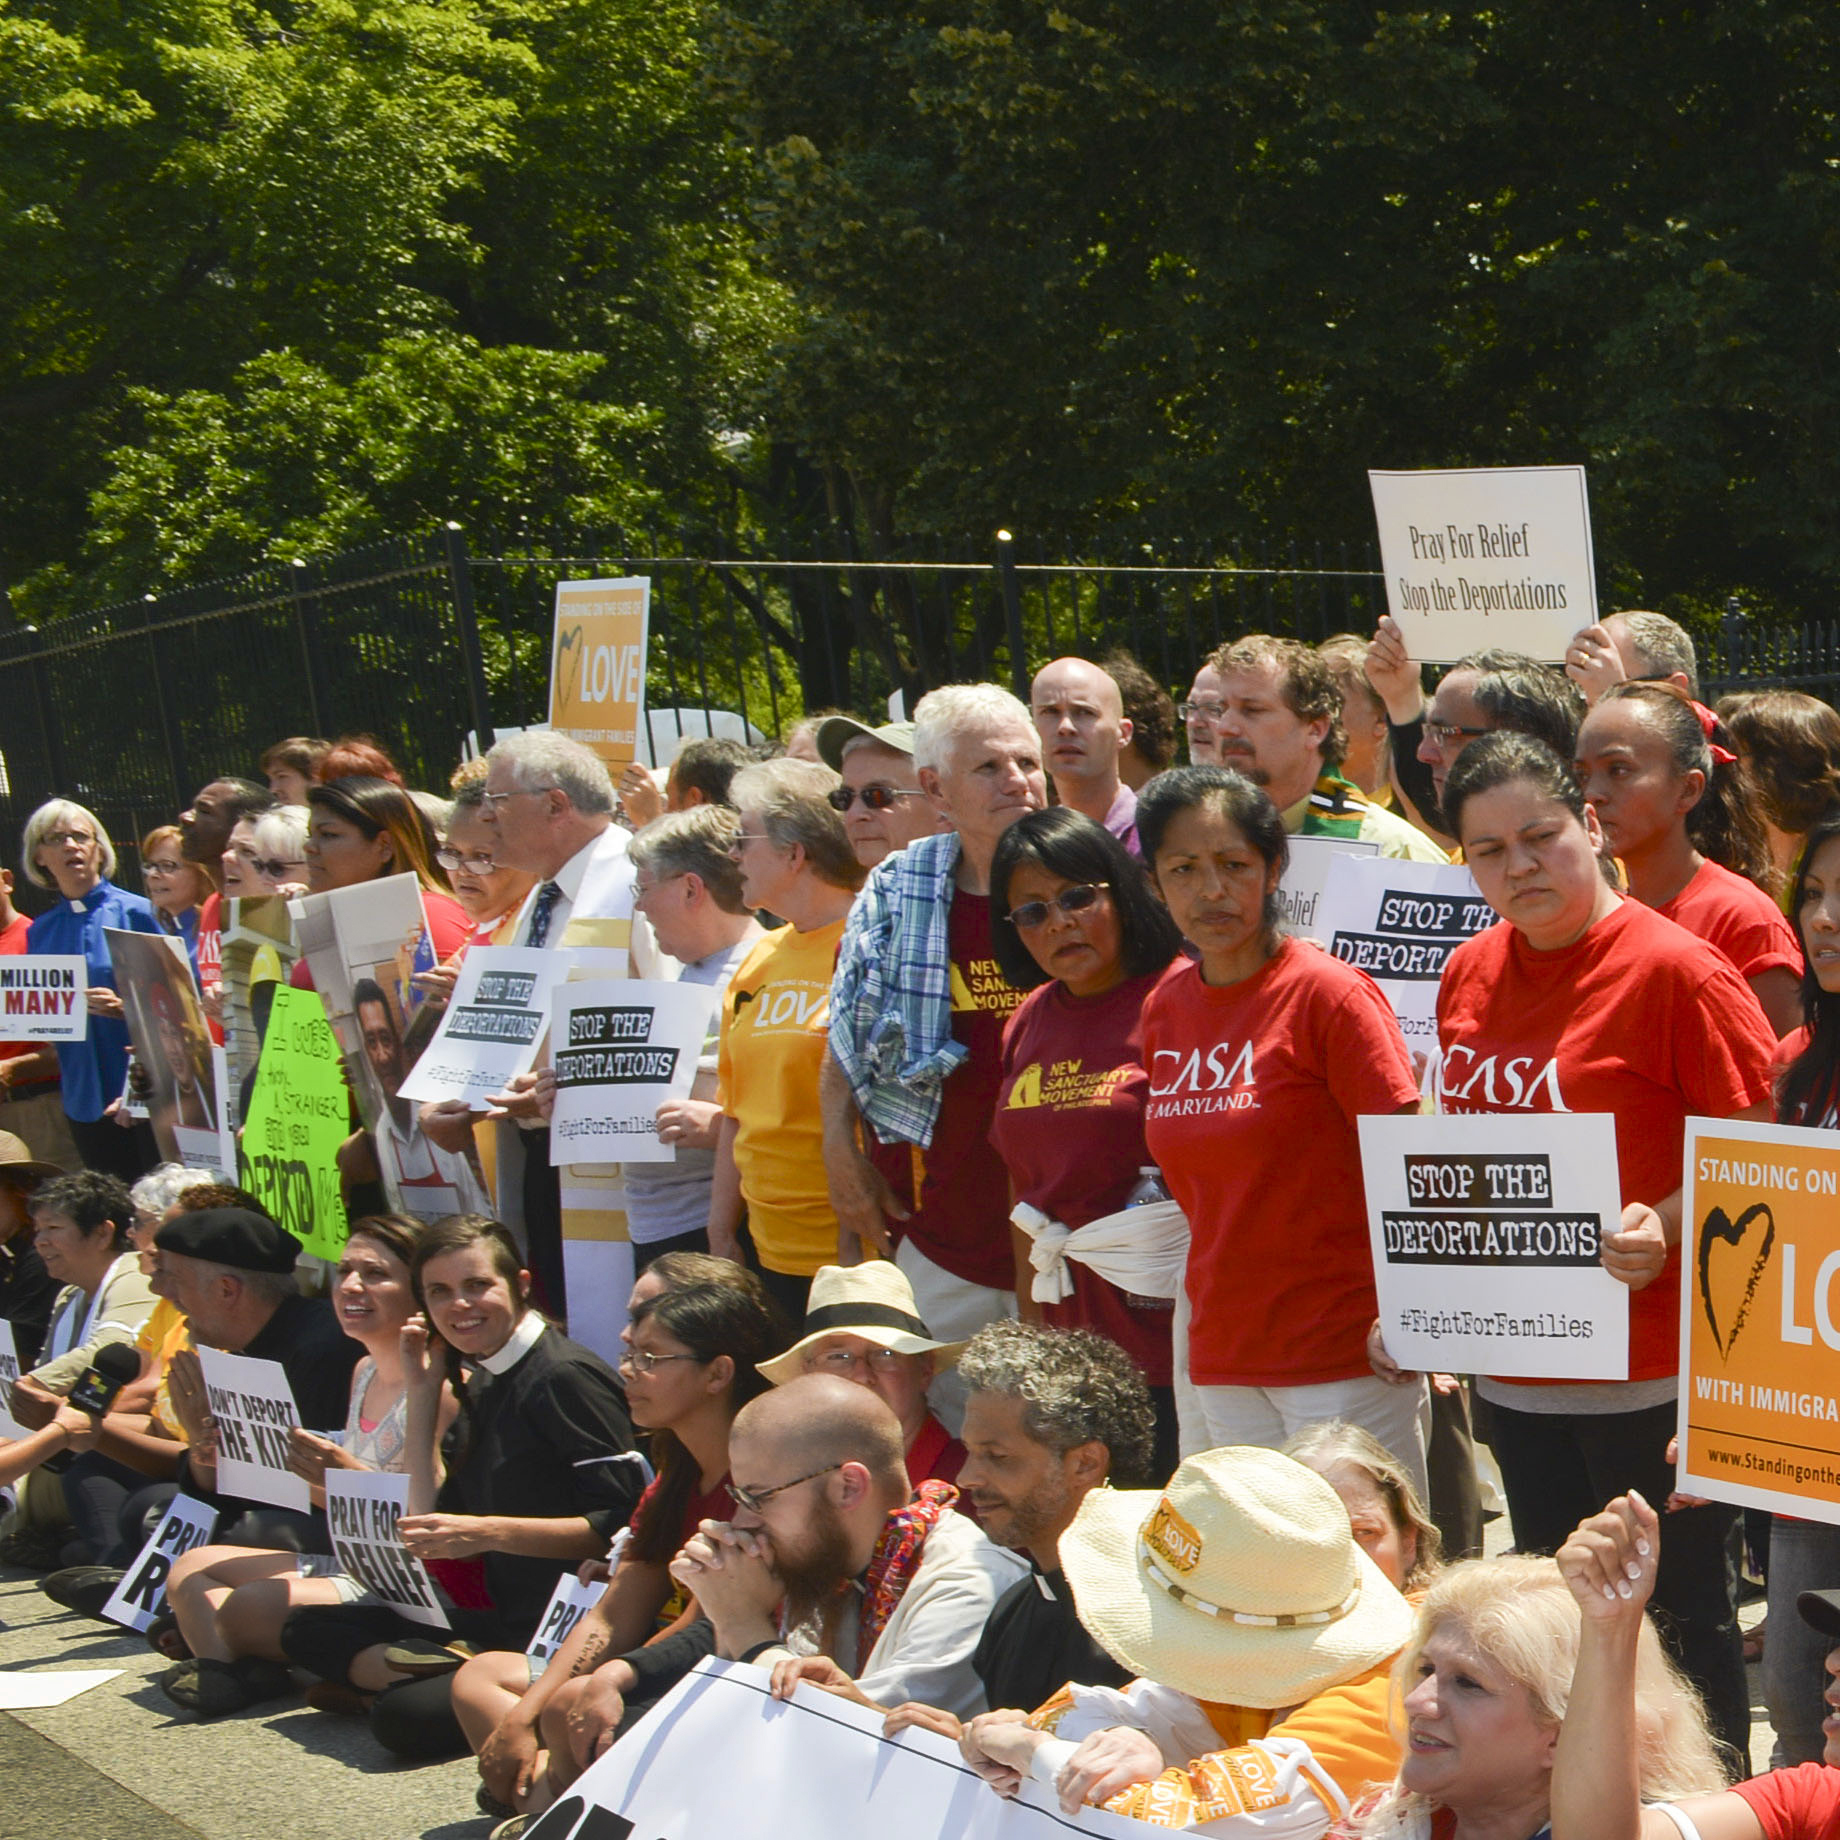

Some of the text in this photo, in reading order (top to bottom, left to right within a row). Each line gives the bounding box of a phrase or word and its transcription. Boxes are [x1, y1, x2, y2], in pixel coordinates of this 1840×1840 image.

[1409, 523, 1530, 564] Pray For Relief
[1400, 576, 1567, 616] Stop the Deportations
[580, 645, 640, 703] LOVE
[1381, 898, 1504, 931] STOP TH
[1335, 937, 1457, 973] DEPORTA
[5, 991, 75, 1015] MANY
[477, 977, 533, 1002] STOP THE
[447, 1012, 540, 1039] DEPORTATIONS
[570, 1012, 650, 1040] STOP THE
[1043, 1070, 1132, 1090] SANCTUARY
[1050, 1059, 1082, 1076] NEW
[1149, 1040, 1256, 1096] CASA
[1442, 1045, 1573, 1112] CASA
[1040, 1084, 1116, 1104] MOVEMENT
[1155, 1093, 1253, 1119] MARYLAND
[1409, 1164, 1549, 1199] STOP THE
[1699, 1158, 1798, 1191] STANDING
[1805, 1169, 1837, 1195] ON
[1384, 1220, 1598, 1257] DEPORTATIONS
[1400, 1309, 1593, 1339] #FightForFamilies
[208, 1384, 293, 1428] DON'T DEPORT
[1696, 1376, 1744, 1406] WITH
[329, 1495, 403, 1542] PRAY FOR
[1165, 1523, 1199, 1564] LOVE
